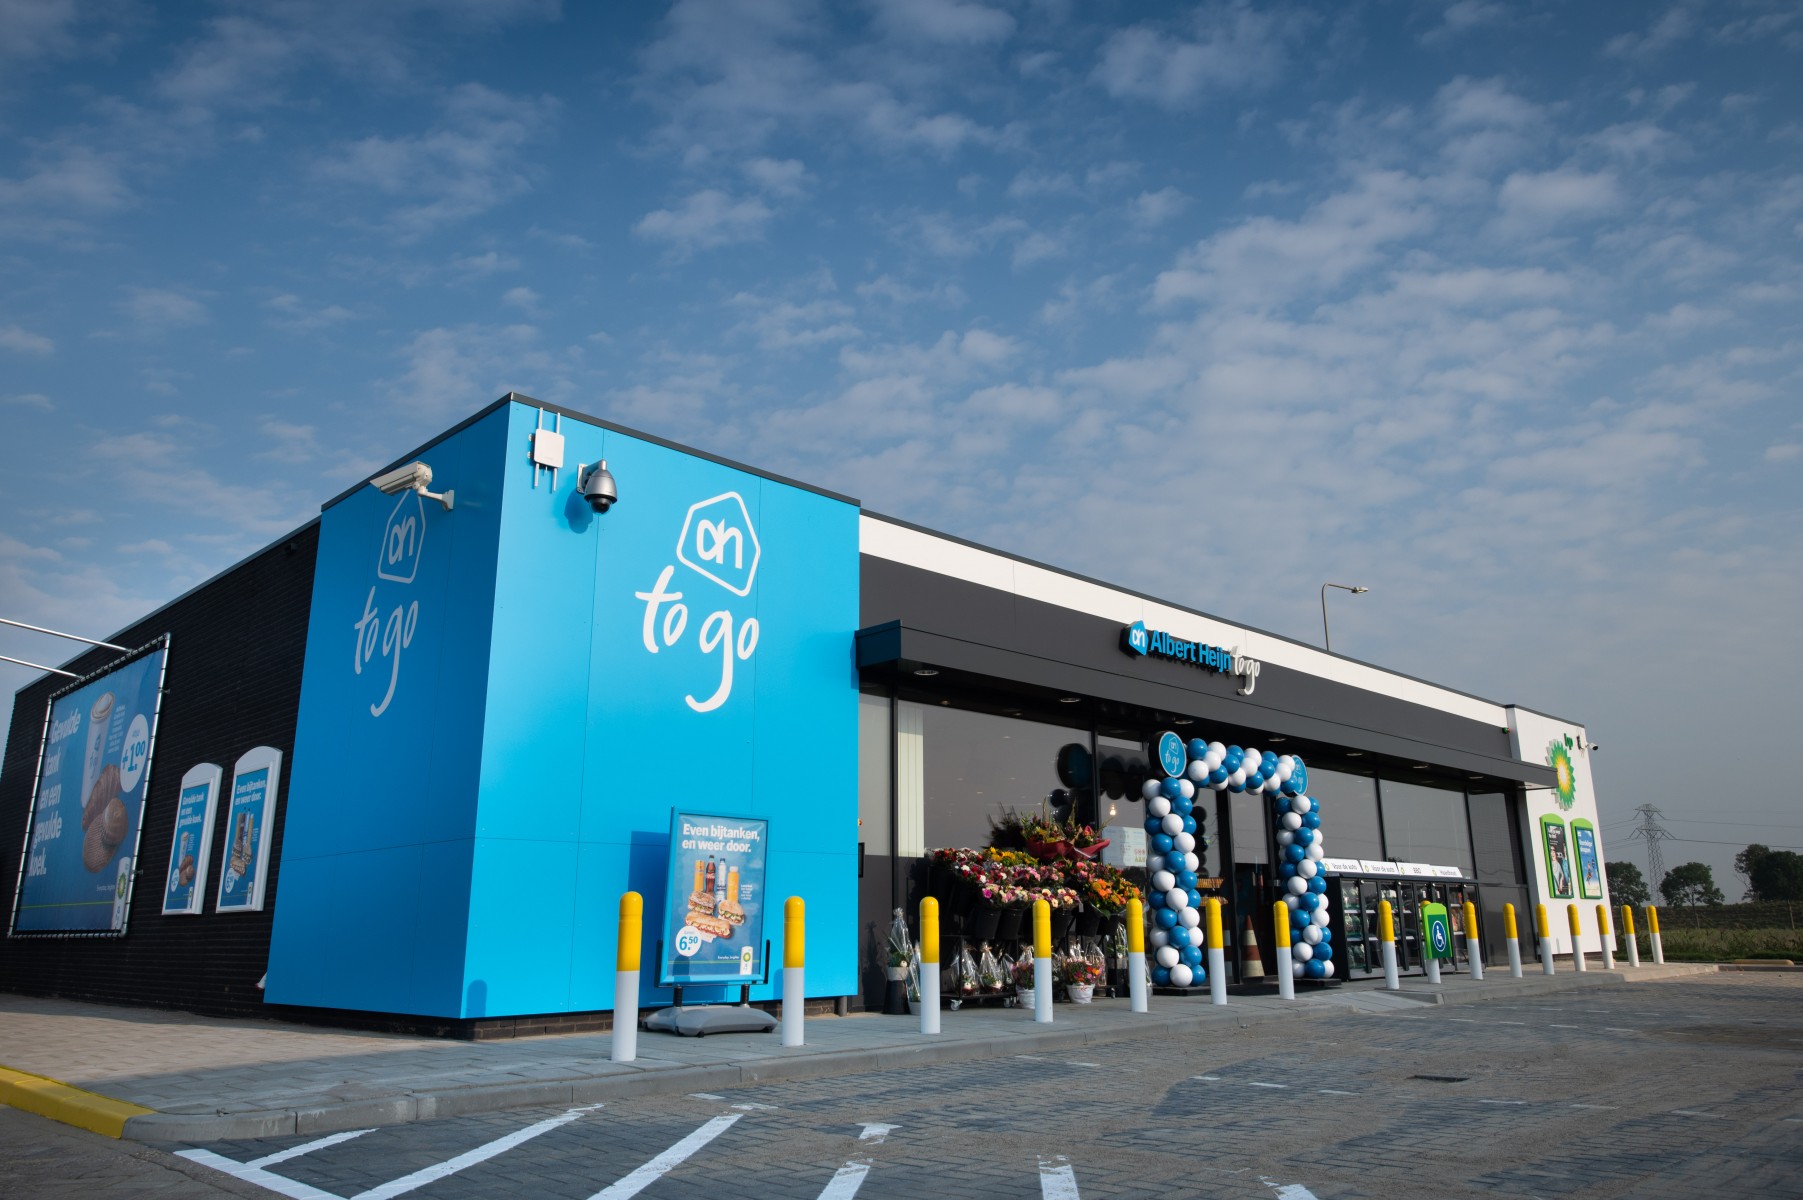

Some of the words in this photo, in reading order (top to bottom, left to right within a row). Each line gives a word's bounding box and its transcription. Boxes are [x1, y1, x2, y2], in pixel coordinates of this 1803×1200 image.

[354, 586, 380, 674] to
[370, 600, 419, 717] go
[635, 565, 688, 653] to
[685, 609, 759, 712] go
[1150, 630, 1196, 662] Albert
[1199, 642, 1232, 673] Heijn
[1231, 647, 1245, 676] to
[1238, 658, 1261, 695] go
[34, 812, 62, 849] gevulde
[682, 823, 709, 836] Even
[710, 825, 760, 842] bijtanken,
[682, 839, 696, 850] en
[698, 841, 725, 851] weer
[726, 839, 752, 853] door.
